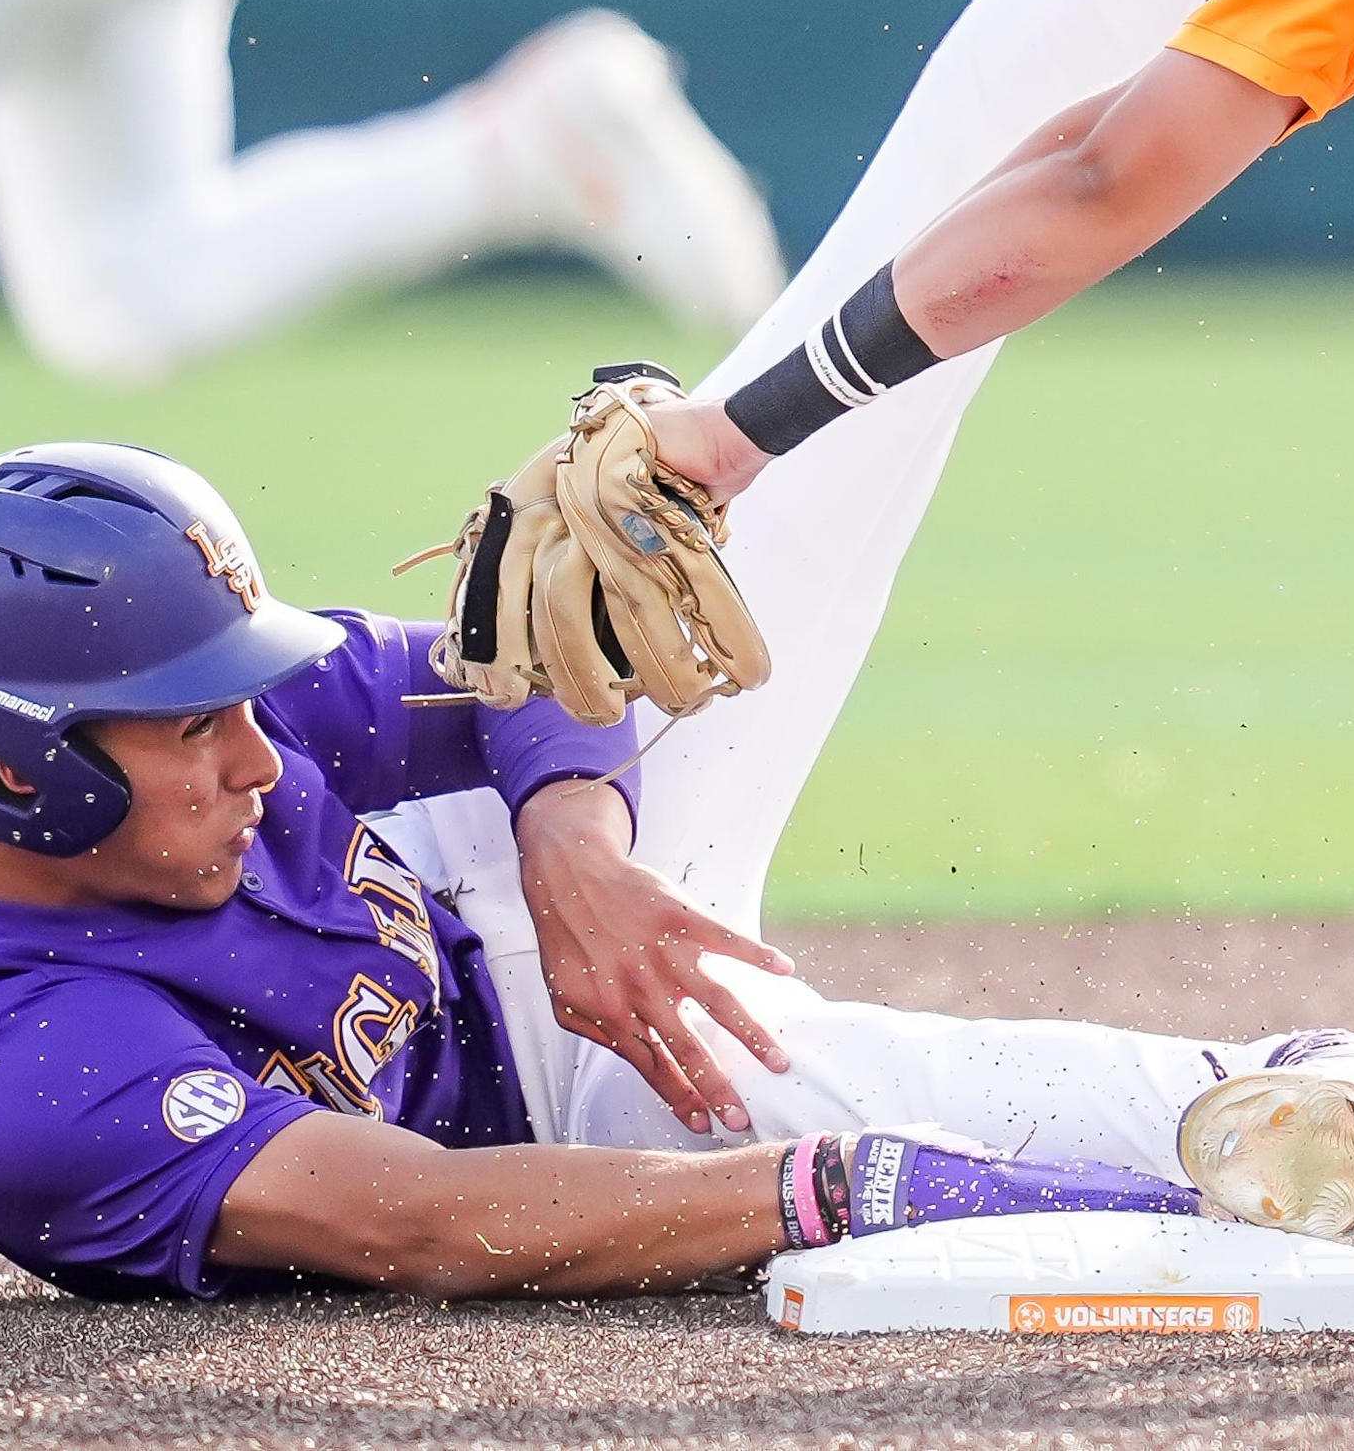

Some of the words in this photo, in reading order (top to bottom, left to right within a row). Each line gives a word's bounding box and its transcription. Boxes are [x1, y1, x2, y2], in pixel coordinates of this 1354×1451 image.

[169, 1073, 241, 1140] SEC
[872, 1138, 905, 1226] BENIK
[1054, 1305, 1214, 1327] VOLUNTEERS
[1226, 1304, 1252, 1330] SEC
